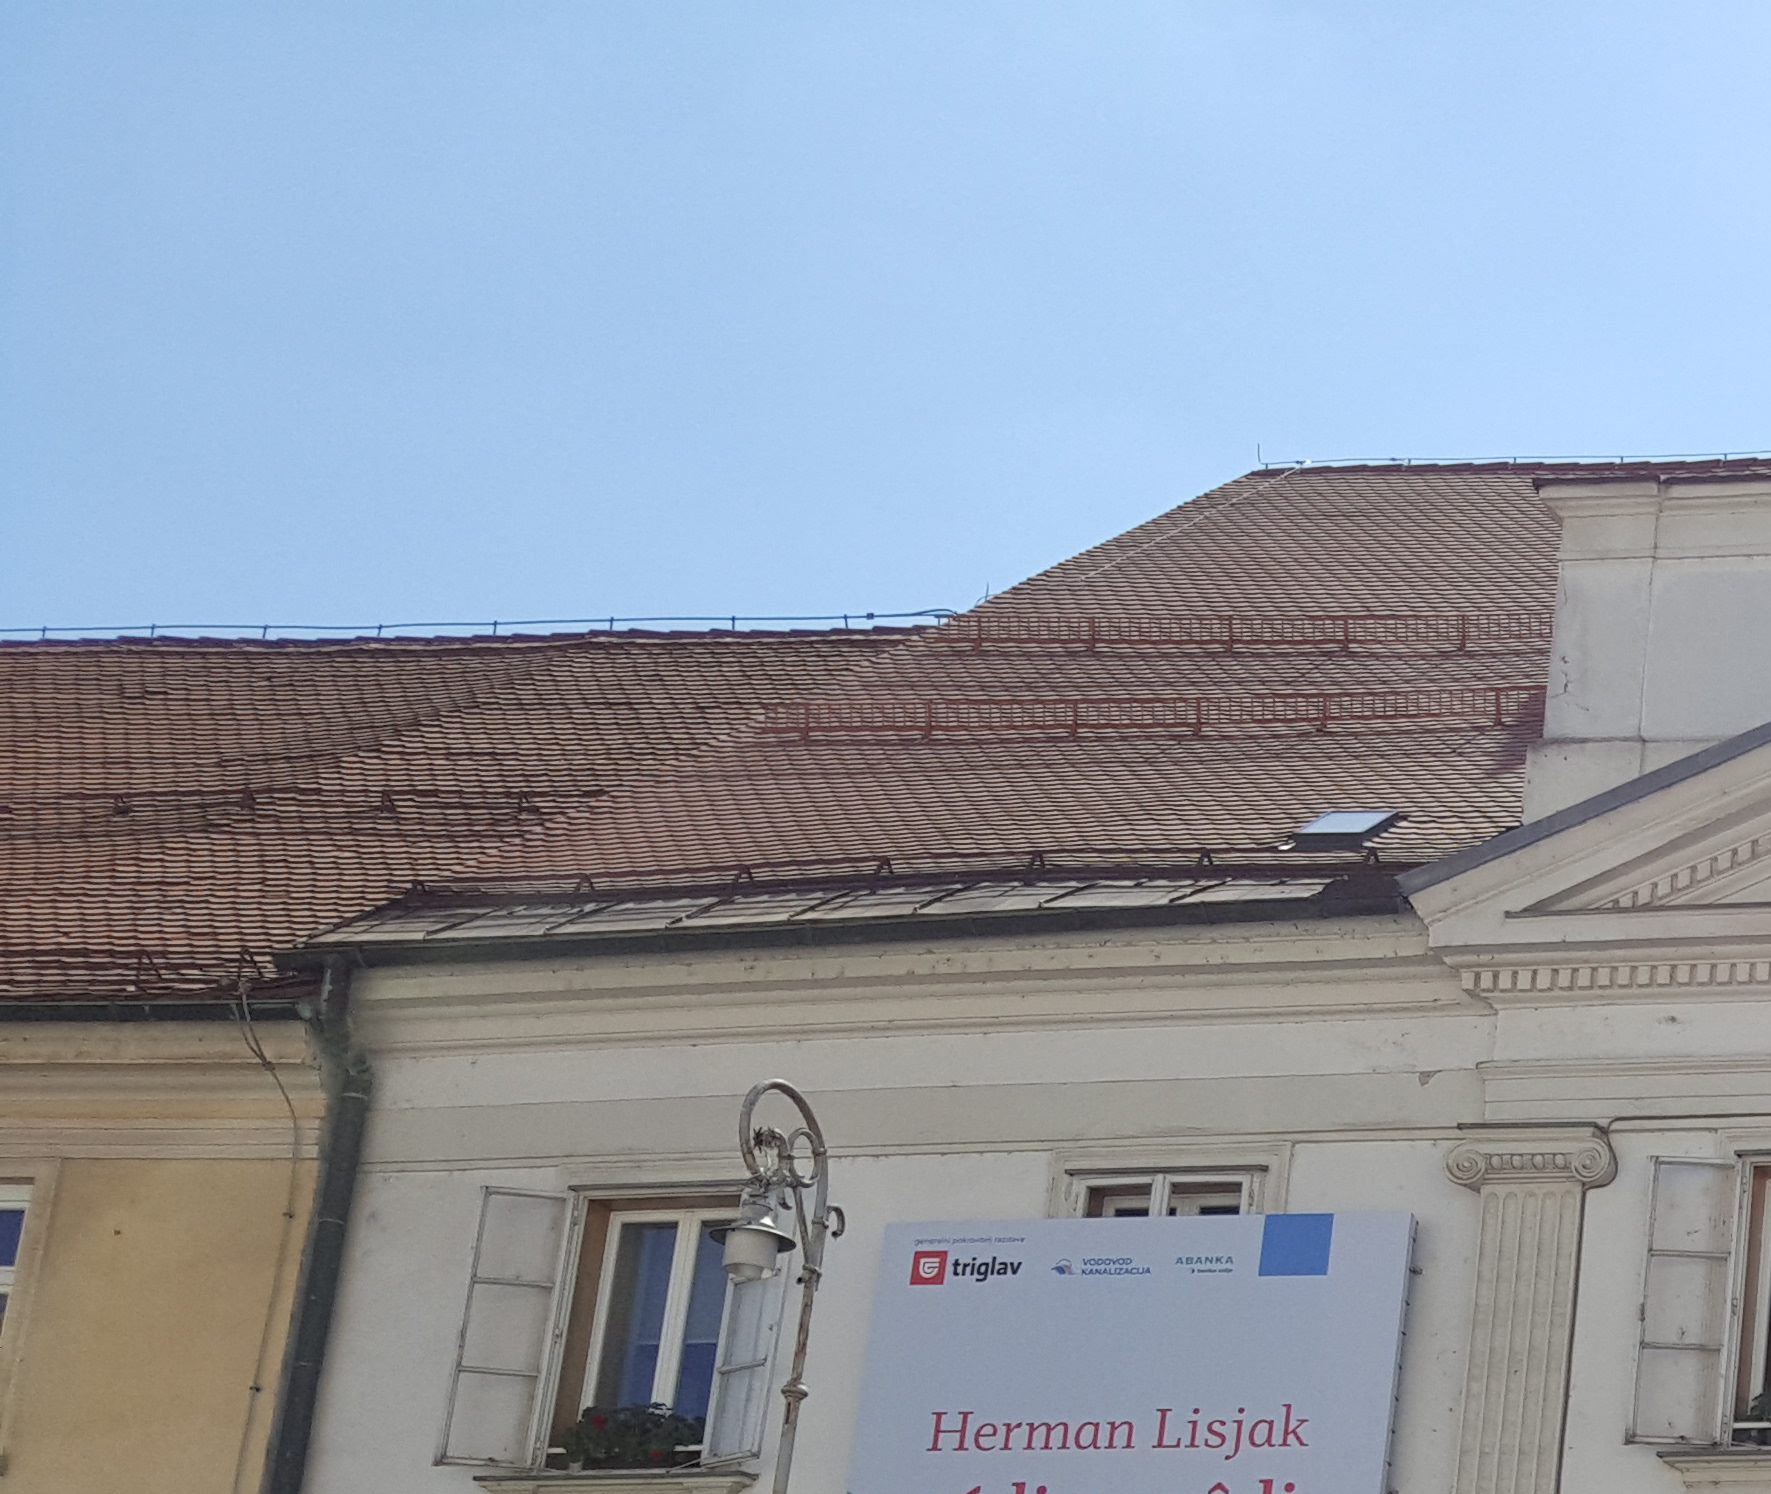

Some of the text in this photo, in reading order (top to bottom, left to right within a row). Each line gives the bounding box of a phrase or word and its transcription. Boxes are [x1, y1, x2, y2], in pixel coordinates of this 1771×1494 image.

[952, 1256, 1023, 1282] triglav
[1082, 1258, 1133, 1266] VODOVOD
[1175, 1256, 1234, 1265] ABANKA
[926, 1403, 1310, 1461] Herman Lisjak
